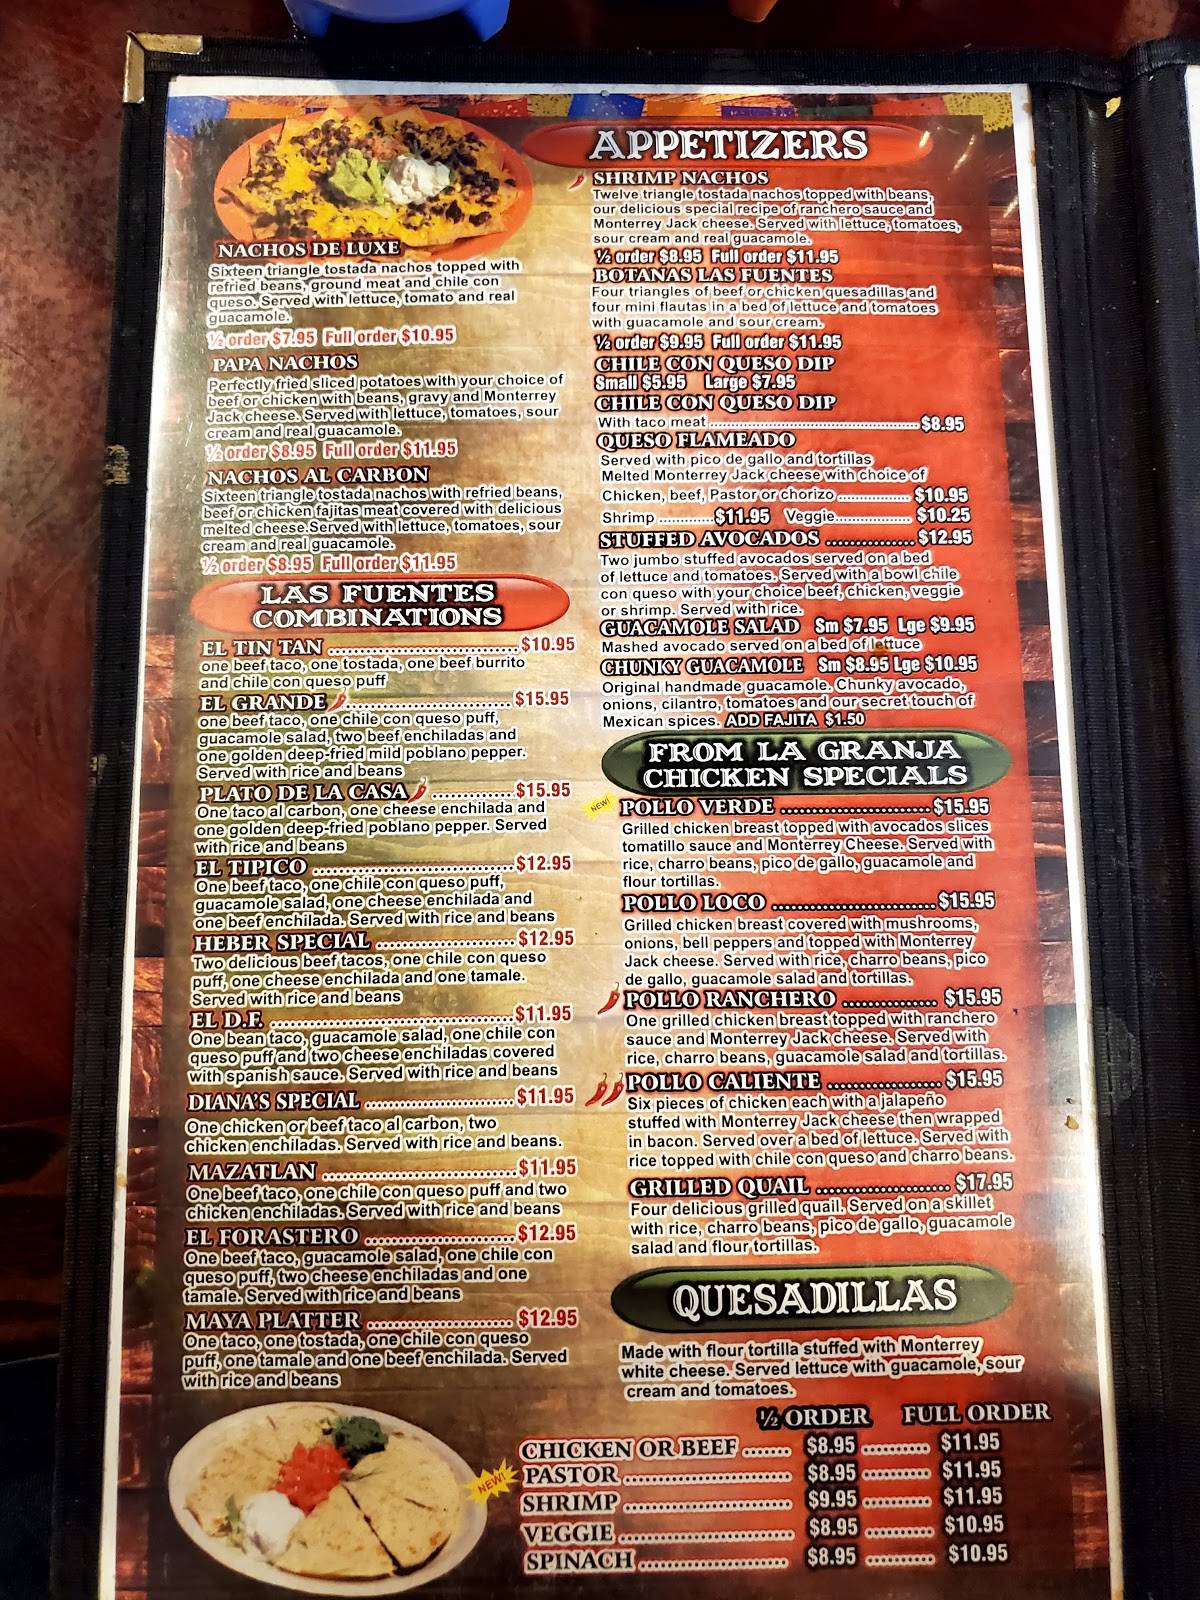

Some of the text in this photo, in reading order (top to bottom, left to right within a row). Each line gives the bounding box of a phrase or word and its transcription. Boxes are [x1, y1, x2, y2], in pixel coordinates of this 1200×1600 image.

[589, 130, 868, 159] APPETIZERS
[593, 171, 768, 185] SHRIMP NACHOS
[593, 189, 932, 202] Twelve triangle tostada nachos topped with beans,
[219, 242, 400, 257] NACHOS DE LUXE
[594, 269, 832, 282] BOTANAS LAS FUENTES
[213, 356, 358, 371] PAPA NACHOS
[596, 357, 835, 373] CHILE CON QUESO DIP
[595, 375, 795, 392] Small $5.95 Large $7.95
[596, 396, 837, 413] CHILE CON QUESO DIP
[598, 416, 964, 432] With taco meat $8.95
[598, 433, 796, 451] QUESO FLAMEADO
[208, 468, 429, 484] NACHOS AL CARBON
[603, 488, 968, 503] Chicken, beef, Pastor or chorizo $10.95
[603, 508, 970, 526] Shrimp $11.95 Veggie $10.25
[600, 530, 972, 548] STUFFED AVOCADOS $12.95
[261, 584, 495, 604] LAS FUENTES
[253, 608, 502, 628] COMBINATIONS
[601, 617, 975, 636] GUACAMOLE SALAD Sm $7.95 Lge $9.95
[202, 637, 575, 656] EL TIN TAN $10.95
[601, 656, 977, 675] CHUNKY GUACAMOLE Sm $8.95 Lge $10.95
[201, 691, 569, 710] EL GRANDE $15.95
[603, 713, 865, 729] Mexican spices. ADD FAJITA $1.50
[649, 740, 960, 762] FROM LA GRANJA
[643, 766, 967, 788] CHICKEN SPECIALS
[200, 783, 571, 802] PLATO DE LA CASA $15.95
[591, 796, 610, 812] NEW!
[621, 798, 989, 815] POLLO VERDE $15.95
[196, 856, 571, 876] EL TIPICO $12.95
[623, 893, 995, 911] POLLO LOCO $15.95
[194, 931, 574, 952] HEBER SPECIAL $12.95
[625, 989, 1001, 1008] POLLO RANCHERO $15.95
[190, 1007, 571, 1028] EL D.F. $11.95
[627, 1071, 1003, 1090] POLLO CALIENTE $15.95
[276, 1094, 360, 1109] SPECIAL
[517, 1089, 574, 1104] $11.95
[188, 1160, 576, 1180] MAZATLAN $11.95
[629, 1174, 1013, 1196] GRILLED QUAIL $17.95
[187, 1226, 575, 1245] EL FORASTERO $12.95
[673, 1278, 957, 1321] QUESADILLAS
[187, 1310, 577, 1329] MAYA PLATTER $12.95
[786, 1407, 871, 1426] ORDER
[903, 1406, 960, 1423] FULL
[968, 1404, 1051, 1422] ORDER
[522, 1433, 1000, 1460] CHICKEN OR BEEF $8.95 $11.95
[526, 1461, 1001, 1485] PASTOR $8.95 $11.95
[478, 1473, 506, 1495] NEW!
[524, 1487, 1002, 1514] SHRIMP $9.95 $11.95
[526, 1515, 1004, 1543] VEGGIE $8.95 $10.95
[526, 1544, 1008, 1570] SPINACH $8.95 $10.95
